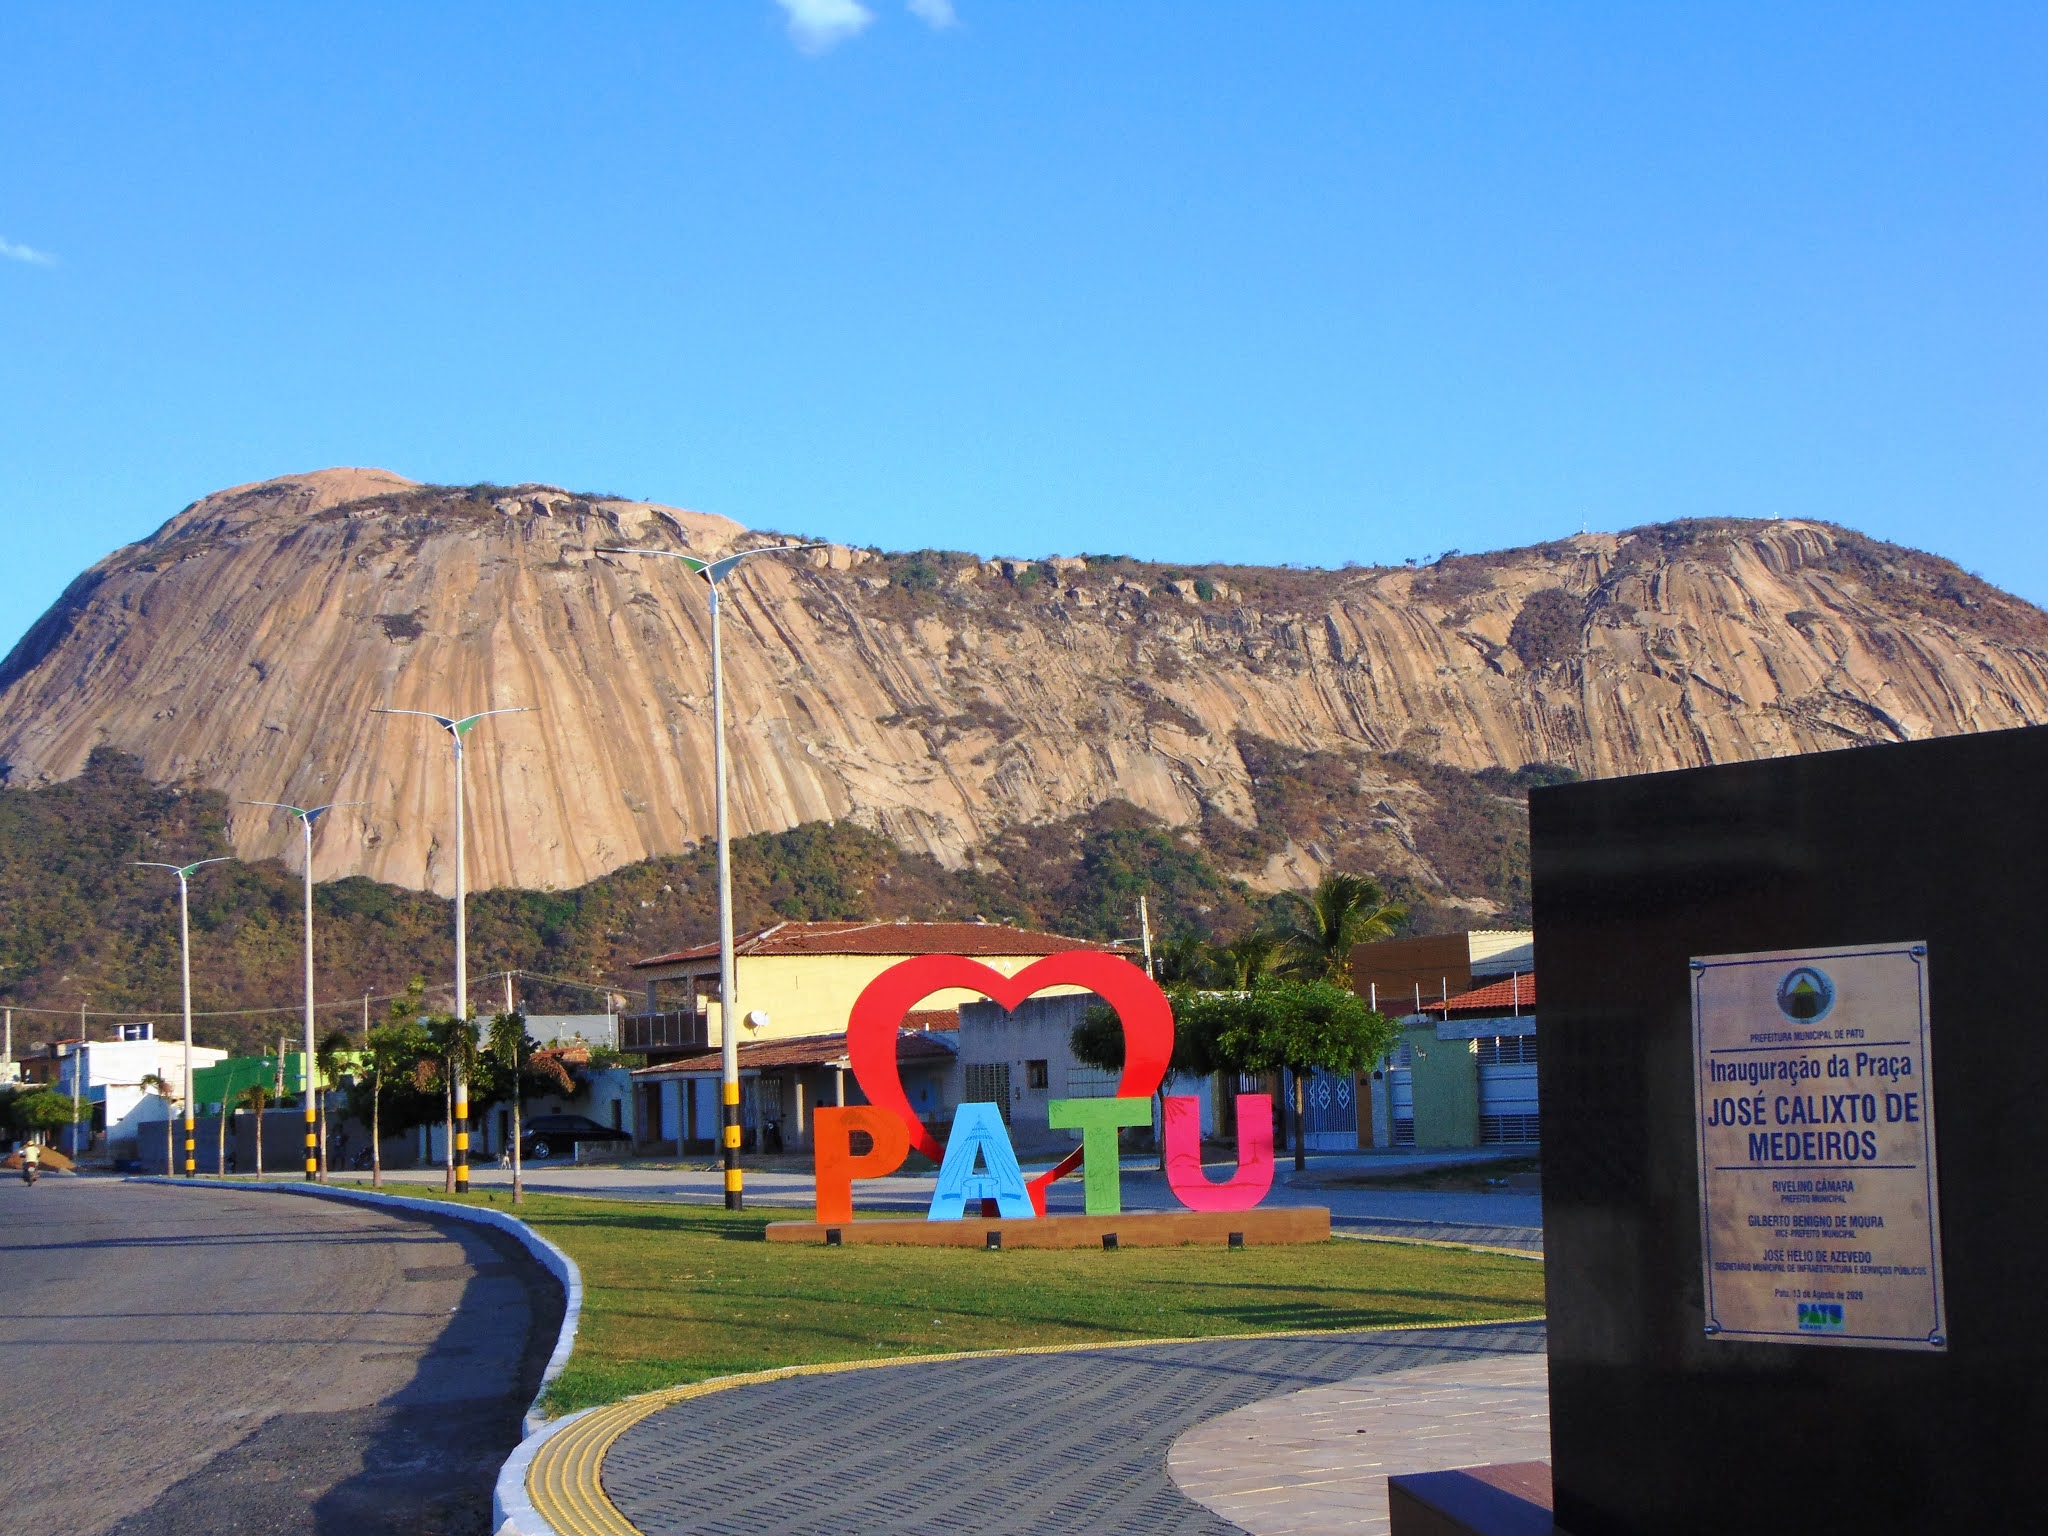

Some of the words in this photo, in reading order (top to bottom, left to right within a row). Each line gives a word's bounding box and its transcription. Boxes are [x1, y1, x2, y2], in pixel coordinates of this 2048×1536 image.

[1750, 1032, 1792, 1043] PREFEITURA
[1793, 1030, 1832, 1041] MUNICIPAL
[1834, 1029, 1844, 1039] DE
[1846, 1028, 1865, 1039] PATU
[1710, 1055, 1821, 1086] Inauguração
[1827, 1053, 1849, 1078] da
[1855, 1052, 1911, 1083] Praça
[1708, 1090, 1767, 1127] JOSÉ
[1775, 1093, 1876, 1125] CALIXTO
[1885, 1092, 1919, 1123] DE
[1748, 1130, 1877, 1161] MEDEIROS
[813, 1093, 1276, 1225] PATU
[1772, 1180, 1813, 1193] RIVELINO
[1815, 1178, 1855, 1192] CÂMARA
[1781, 1194, 1811, 1203] PREFEITO
[1747, 1214, 1790, 1227] GILBERTO
[1793, 1215, 1832, 1228] BENIGNO
[1834, 1215, 1848, 1228] DE
[1849, 1215, 1884, 1228] MOURA
[1815, 1250, 1828, 1263] DE
[1830, 1250, 1872, 1263] AZEVEDO
